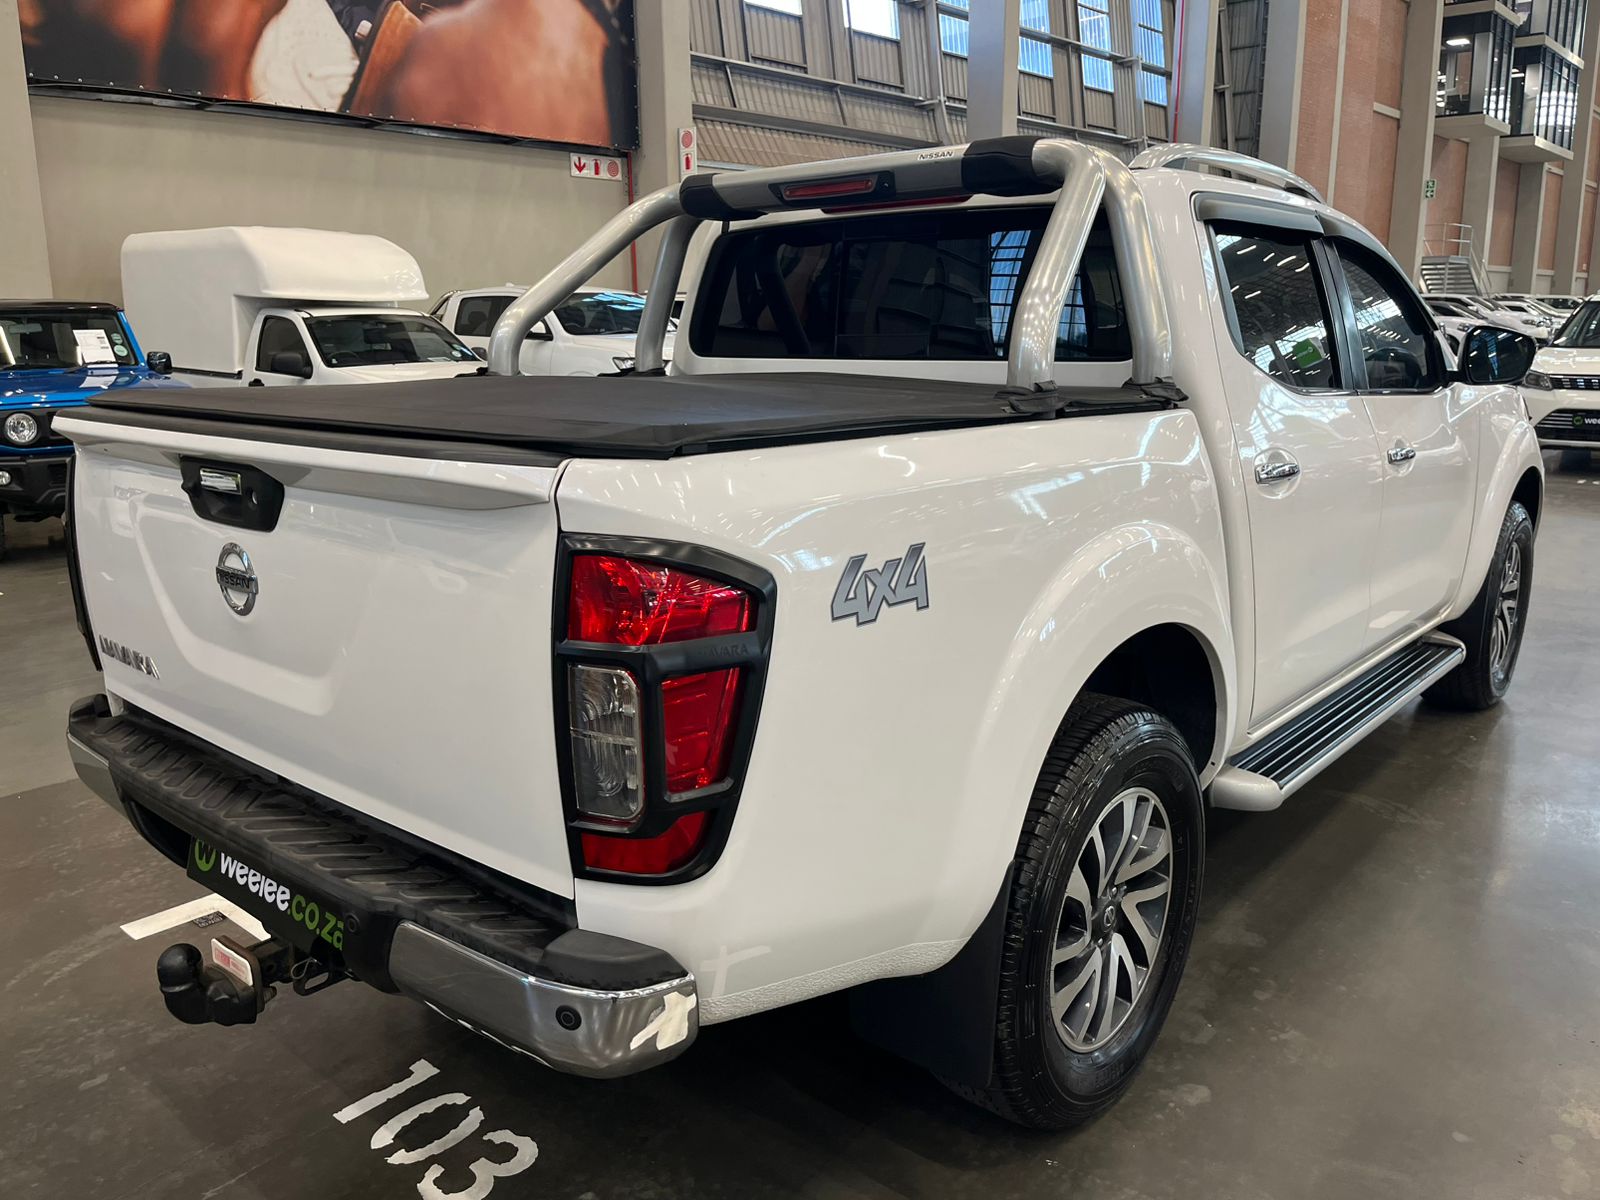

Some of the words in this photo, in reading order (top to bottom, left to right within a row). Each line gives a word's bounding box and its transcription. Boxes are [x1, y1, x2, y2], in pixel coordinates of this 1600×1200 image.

[917, 150, 954, 161] NISSAN
[217, 569, 250, 589] SSAN
[830, 541, 930, 627] 4x4
[699, 642, 750, 657] AVARA
[332, 1058, 539, 1200] 103
